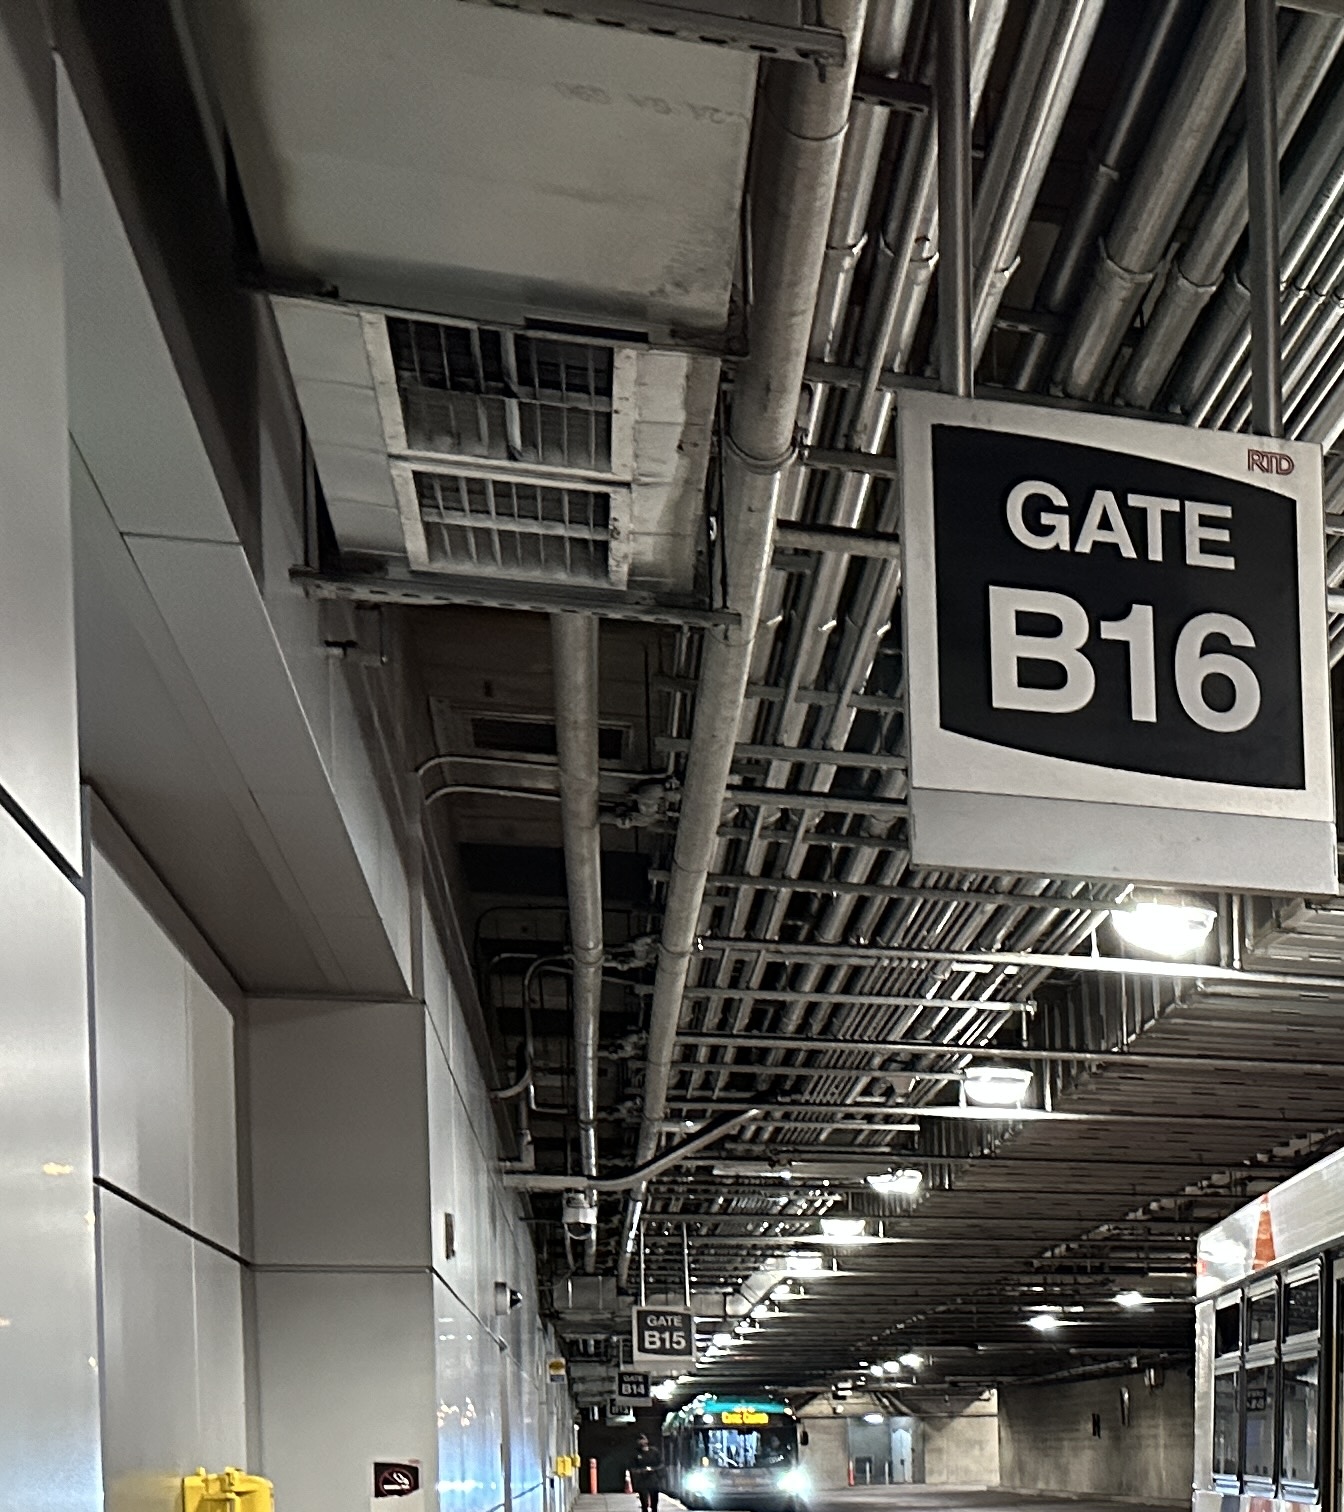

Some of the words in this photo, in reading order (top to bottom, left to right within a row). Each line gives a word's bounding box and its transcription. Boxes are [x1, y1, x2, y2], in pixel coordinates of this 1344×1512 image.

[1247, 448, 1295, 476] RTD
[1005, 479, 1236, 571] GATE
[988, 584, 1262, 734] B16
[646, 1314, 683, 1327] GATE
[644, 1330, 687, 1350] B15
[621, 1383, 645, 1395] B14
